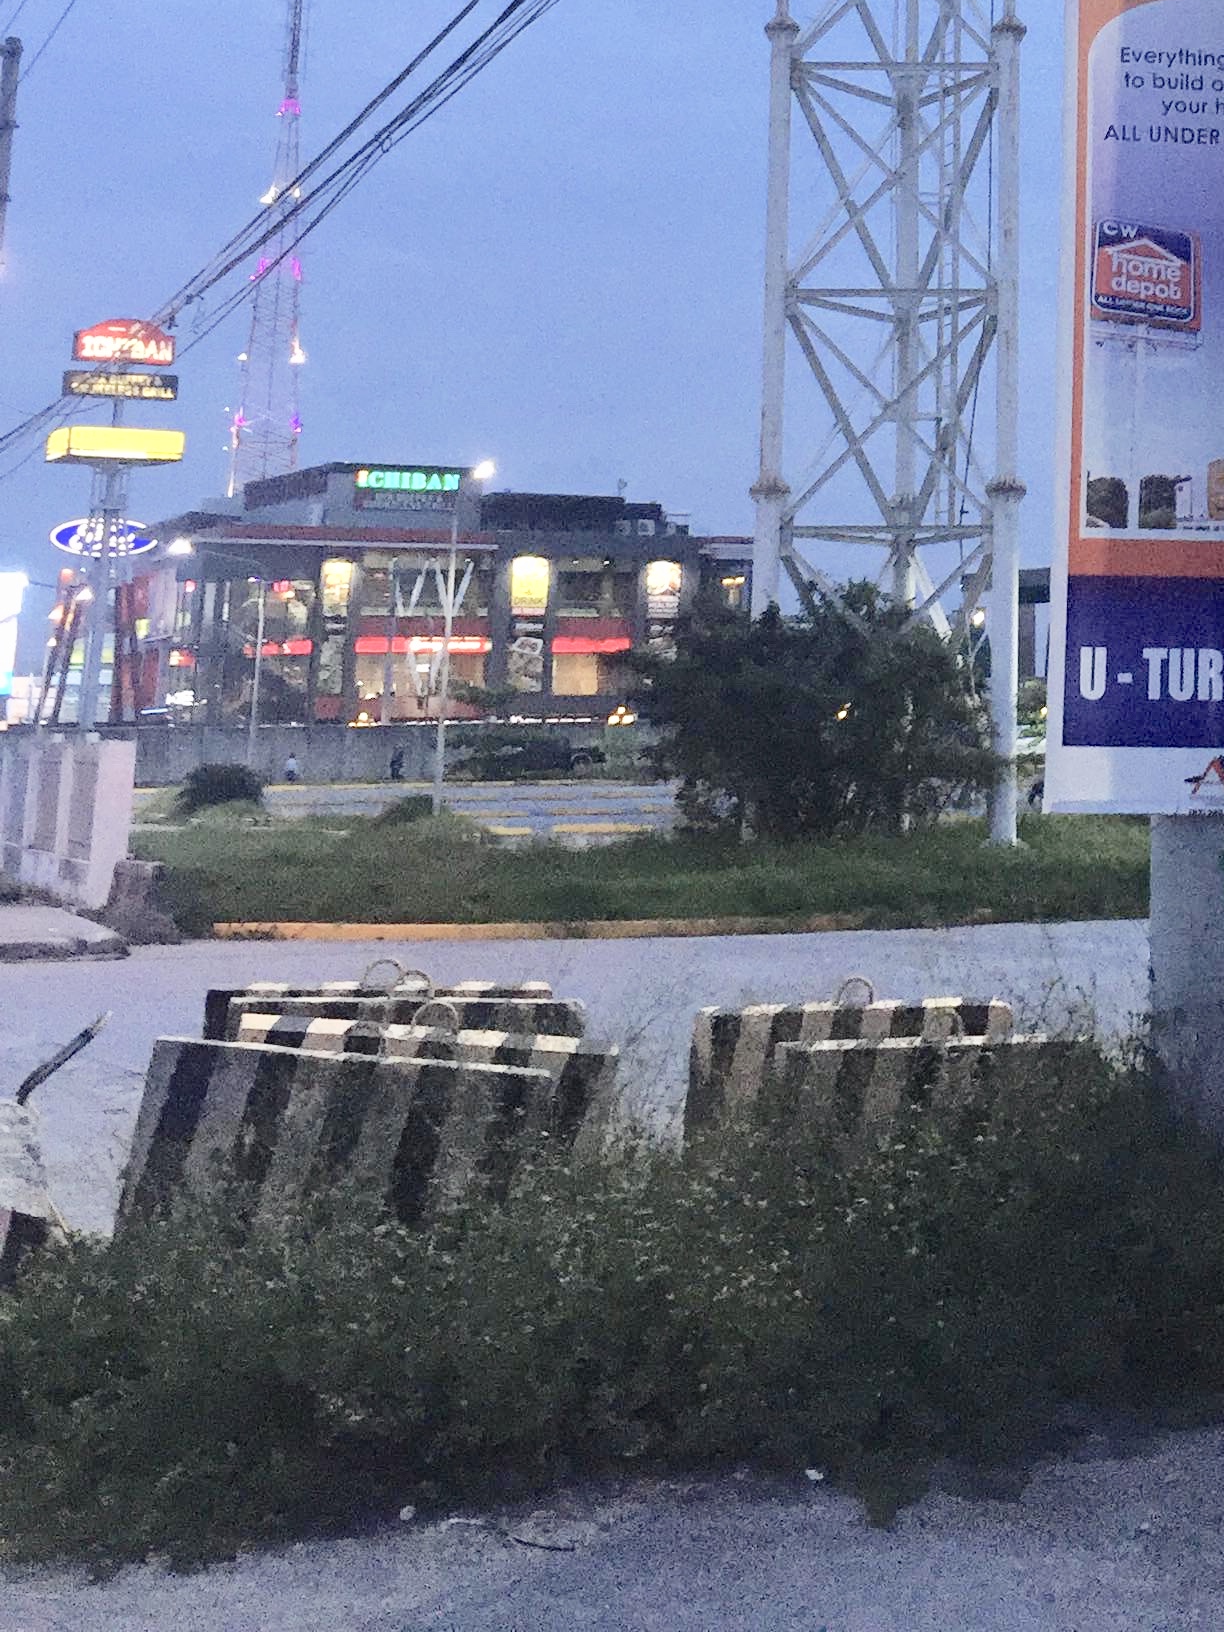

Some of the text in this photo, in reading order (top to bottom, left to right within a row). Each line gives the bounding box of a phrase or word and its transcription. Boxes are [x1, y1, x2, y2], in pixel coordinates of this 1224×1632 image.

[1124, 71, 1145, 89] to
[1152, 72, 1204, 91] build
[1161, 99, 1208, 116] your
[1104, 124, 1141, 142] ALL
[1149, 125, 1220, 145] UNDER
[1102, 220, 1140, 238] CW
[1111, 251, 1181, 282] home
[1111, 274, 1182, 300] depot
[356, 469, 460, 491] ICHIBAN
[1079, 646, 1107, 701] U
